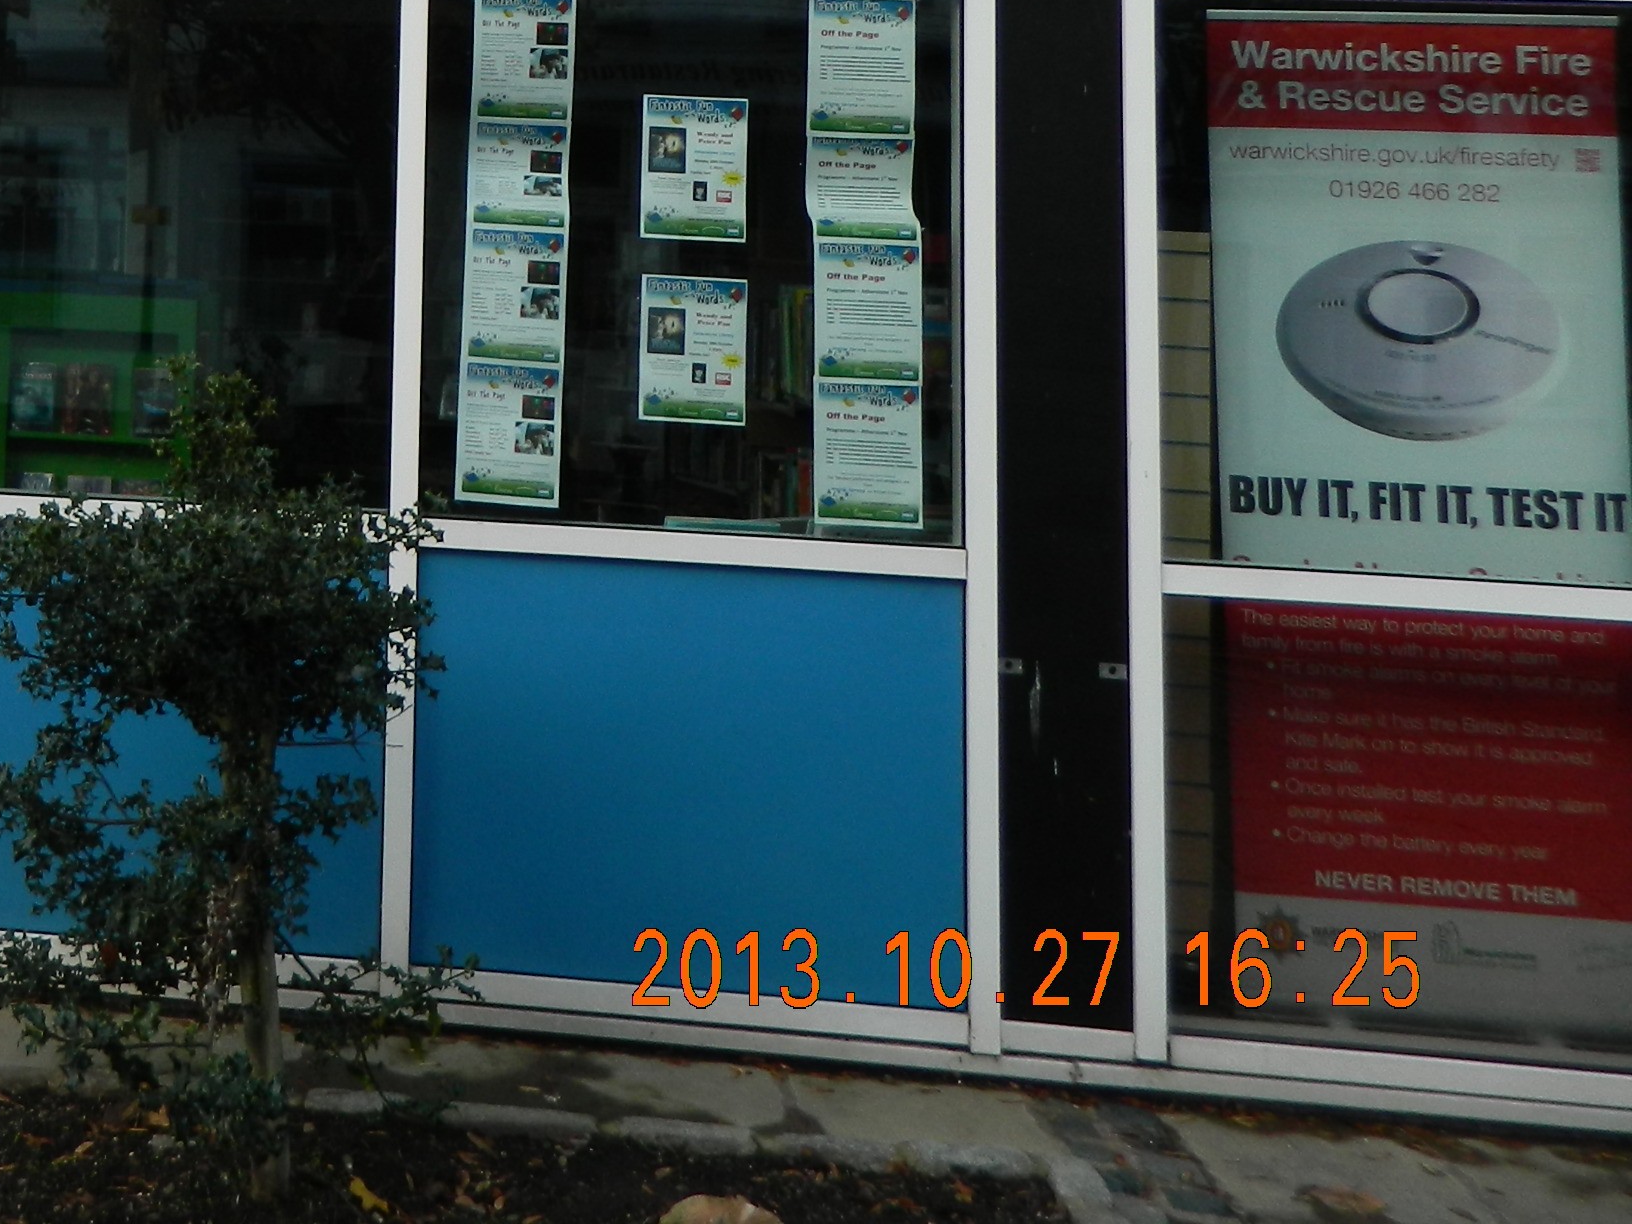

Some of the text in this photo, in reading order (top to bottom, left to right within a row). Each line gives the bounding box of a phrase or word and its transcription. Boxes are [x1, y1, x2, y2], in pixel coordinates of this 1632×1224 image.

[856, 31, 879, 39] Page
[1230, 40, 1592, 77] Warwickshire Fire
[1238, 81, 1590, 117] & Rescue Service
[853, 162, 876, 170] Page
[1229, 142, 1559, 171] warwickshire.gov.uk/firesafety
[1329, 179, 1500, 204] 01926 466 282
[862, 274, 885, 282] Page
[862, 414, 885, 423] Page
[1229, 475, 1627, 533] BUY IT, FIT IT, TEST IT
[1241, 608, 1607, 646] The easiest way to protect your home and
[1295, 635, 1335, 652] from
[1387, 642, 1425, 658] with
[1445, 647, 1504, 663] smoke
[1286, 825, 1356, 850] Change
[1360, 832, 1389, 848] the
[1314, 869, 1580, 907] NEVER REMOVE THEM
